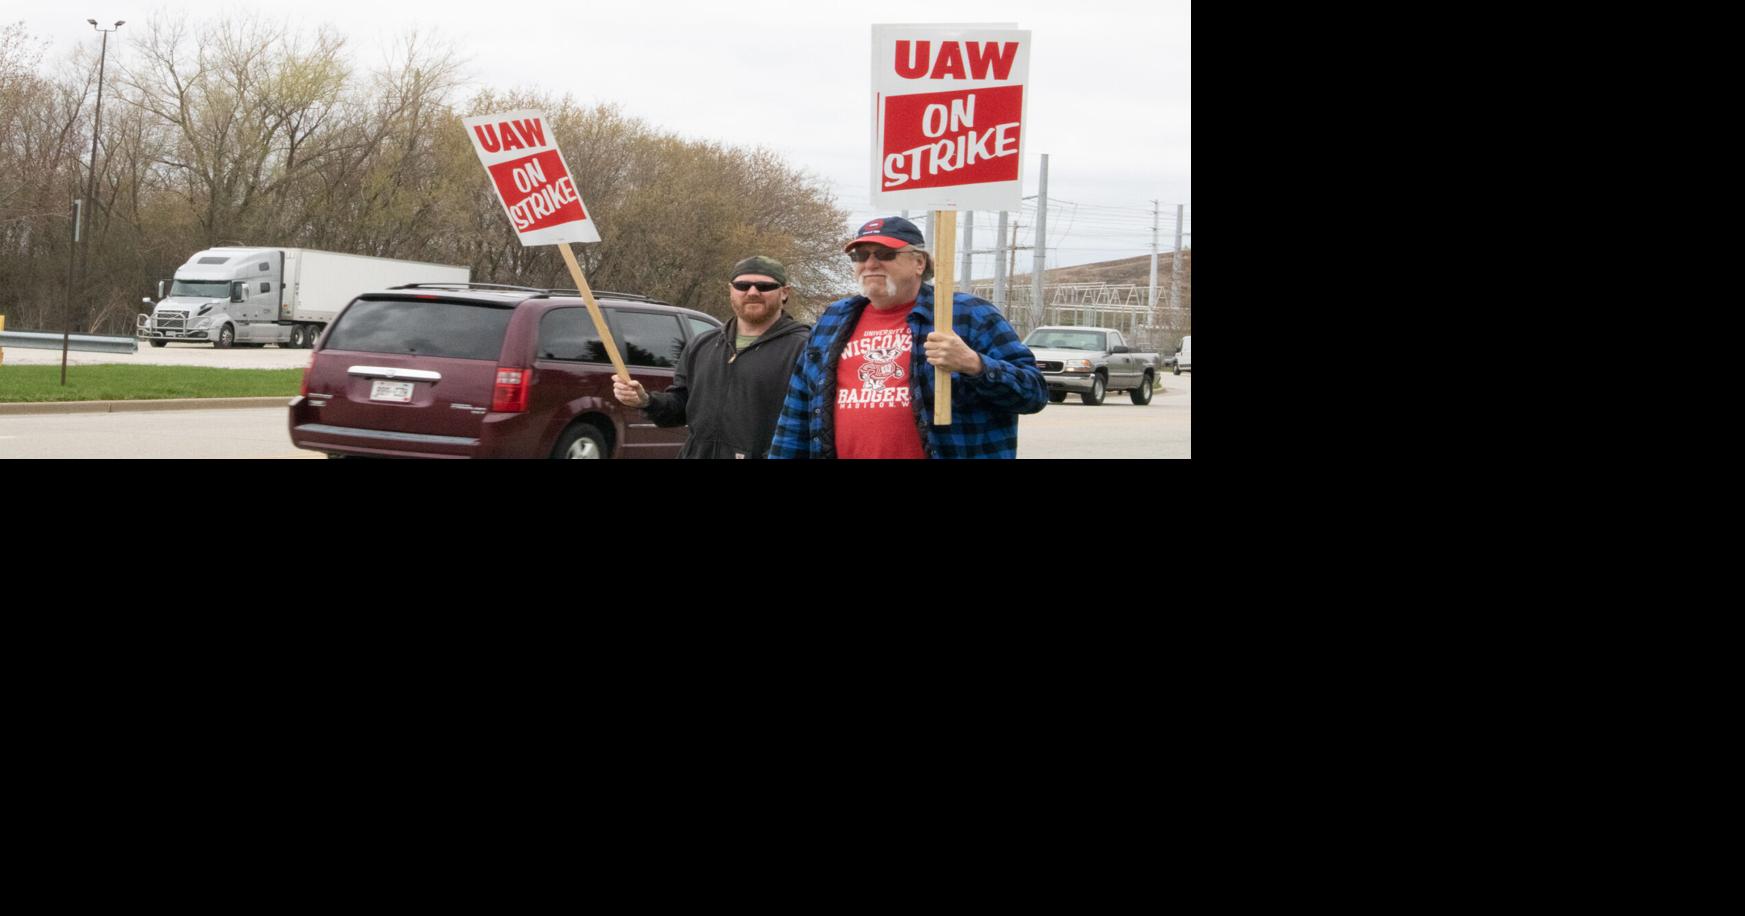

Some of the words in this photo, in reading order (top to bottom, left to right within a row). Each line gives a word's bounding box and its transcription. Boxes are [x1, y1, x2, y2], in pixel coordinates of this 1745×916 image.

[894, 39, 1020, 80] UAW
[921, 93, 976, 138] ON
[473, 118, 547, 153] UAW
[883, 121, 1020, 188] STRIKE
[512, 157, 547, 193] ON
[509, 176, 577, 230] STRIKE
[863, 327, 905, 337] UNIVERSITY
[837, 386, 912, 404] BADGER
